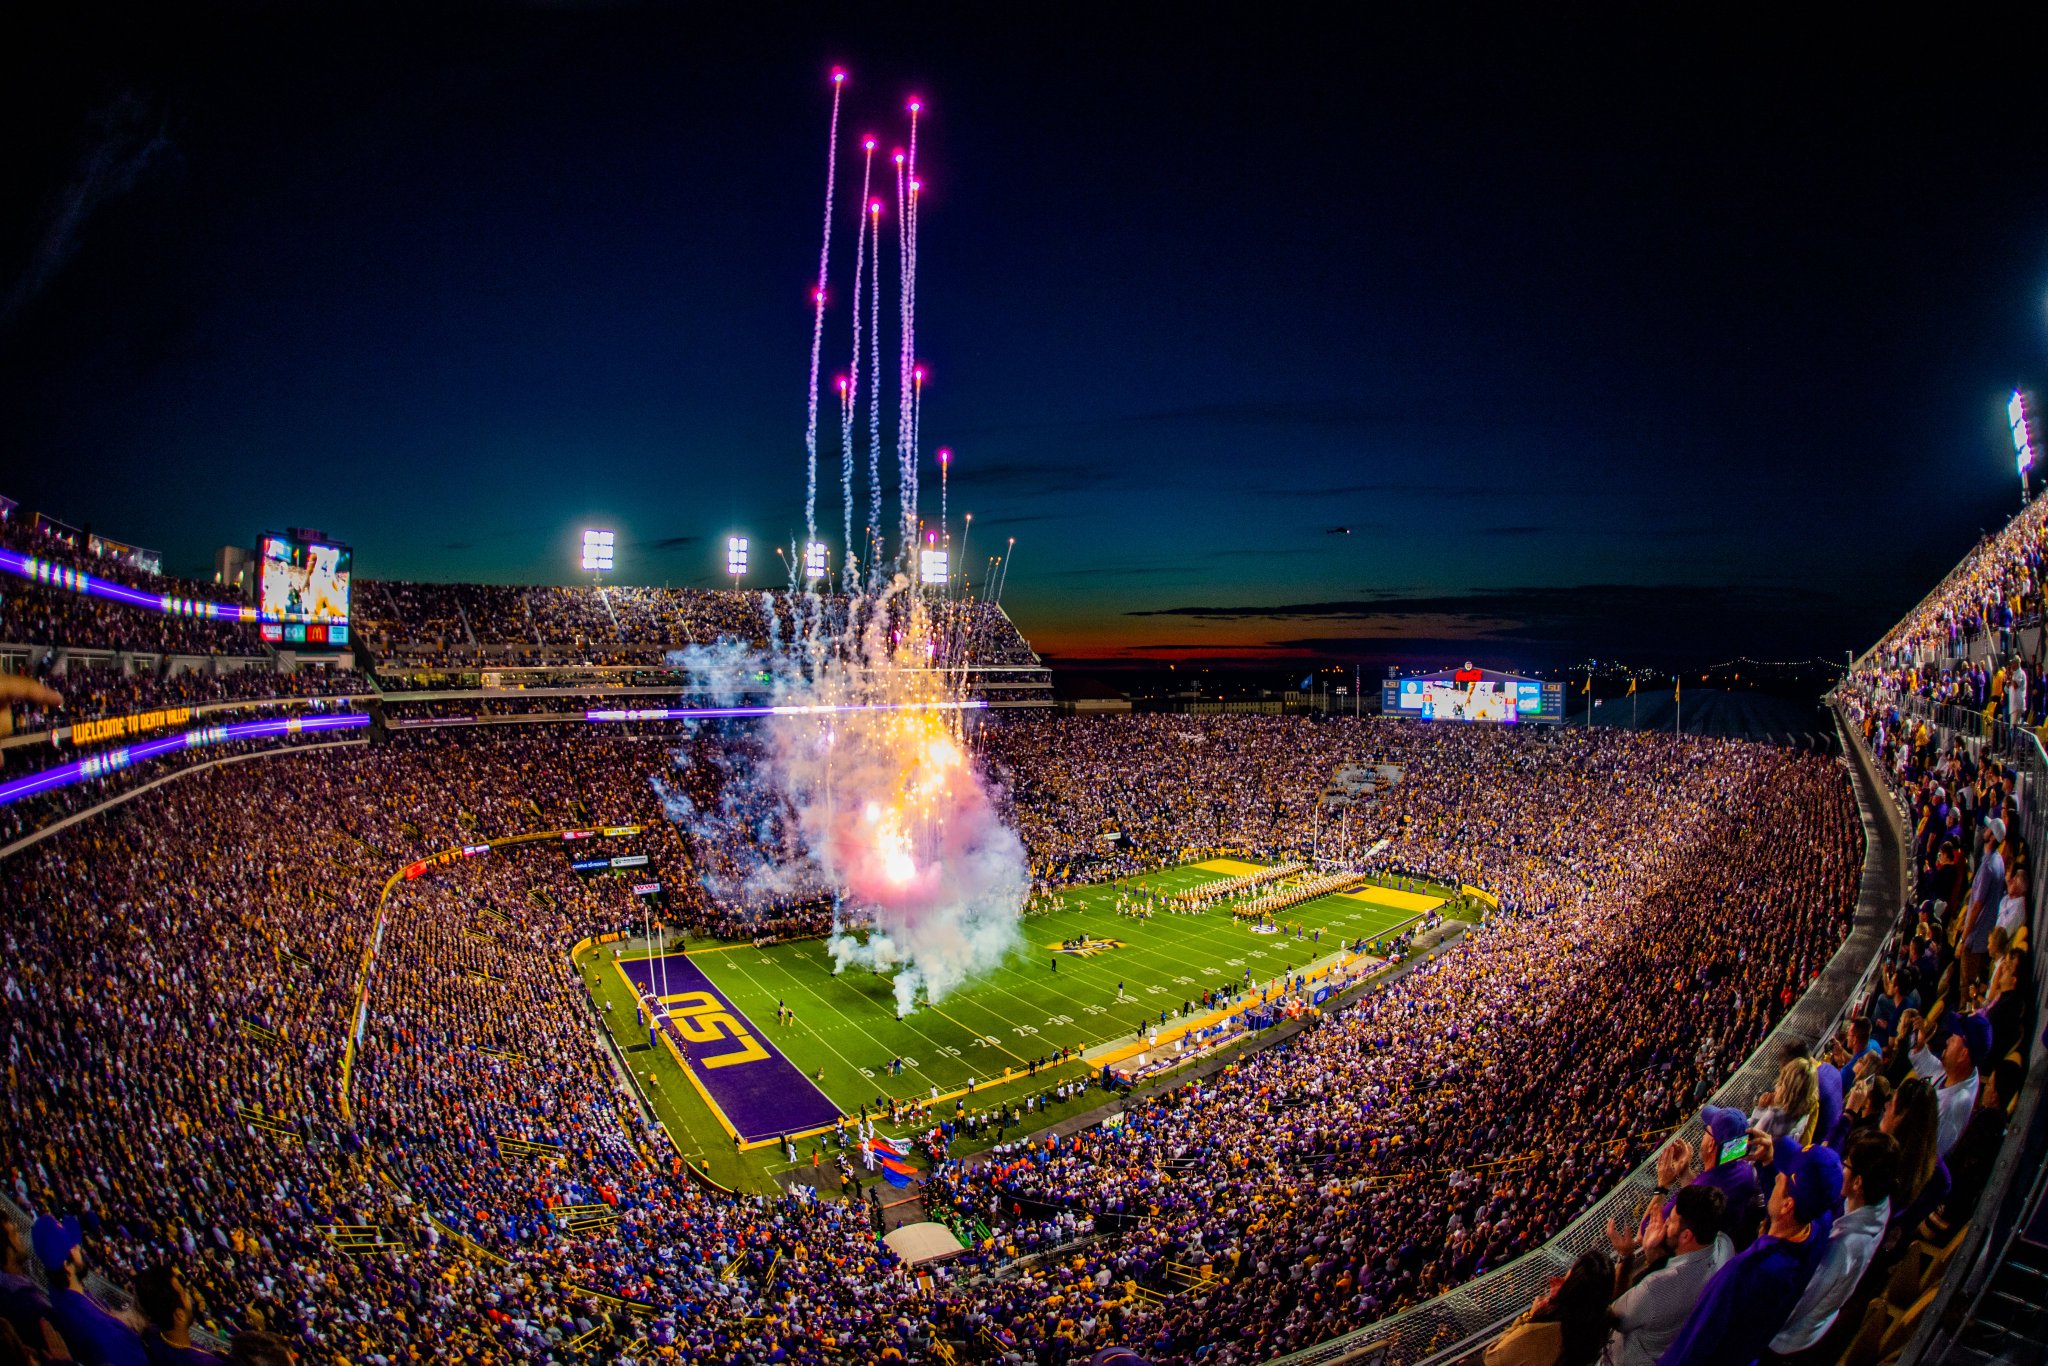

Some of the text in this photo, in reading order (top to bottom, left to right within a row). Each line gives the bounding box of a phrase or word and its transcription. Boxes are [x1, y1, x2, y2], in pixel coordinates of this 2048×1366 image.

[1383, 681, 1399, 689] LSU
[1542, 684, 1560, 692] LSU
[72, 707, 190, 745] WELCOME TO DEATH VALLEY
[1082, 1004, 1107, 1016] 35
[1049, 1014, 1075, 1026] 30
[658, 991, 772, 1069] LSU
[1012, 1024, 1039, 1038] 25
[974, 1035, 1002, 1048] 20
[935, 1045, 962, 1059] 15
[859, 1066, 876, 1078] 5
